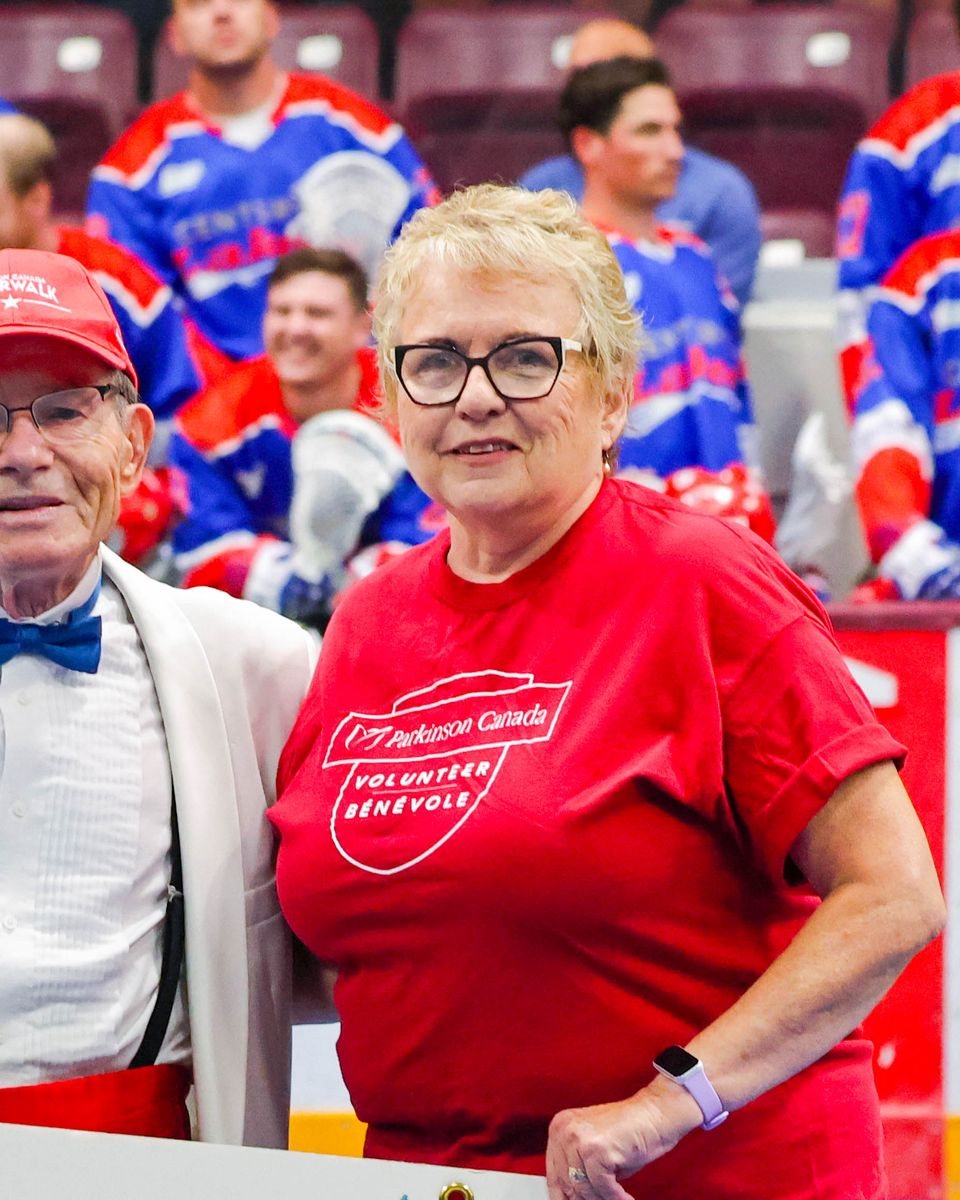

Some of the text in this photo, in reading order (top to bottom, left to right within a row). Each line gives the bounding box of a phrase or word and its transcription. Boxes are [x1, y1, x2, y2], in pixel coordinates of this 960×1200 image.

[384, 703, 548, 748] Parkinson Canada
[355, 762, 490, 790] VOLUNTEER
[344, 791, 470, 819] BÉNÉVOLE
